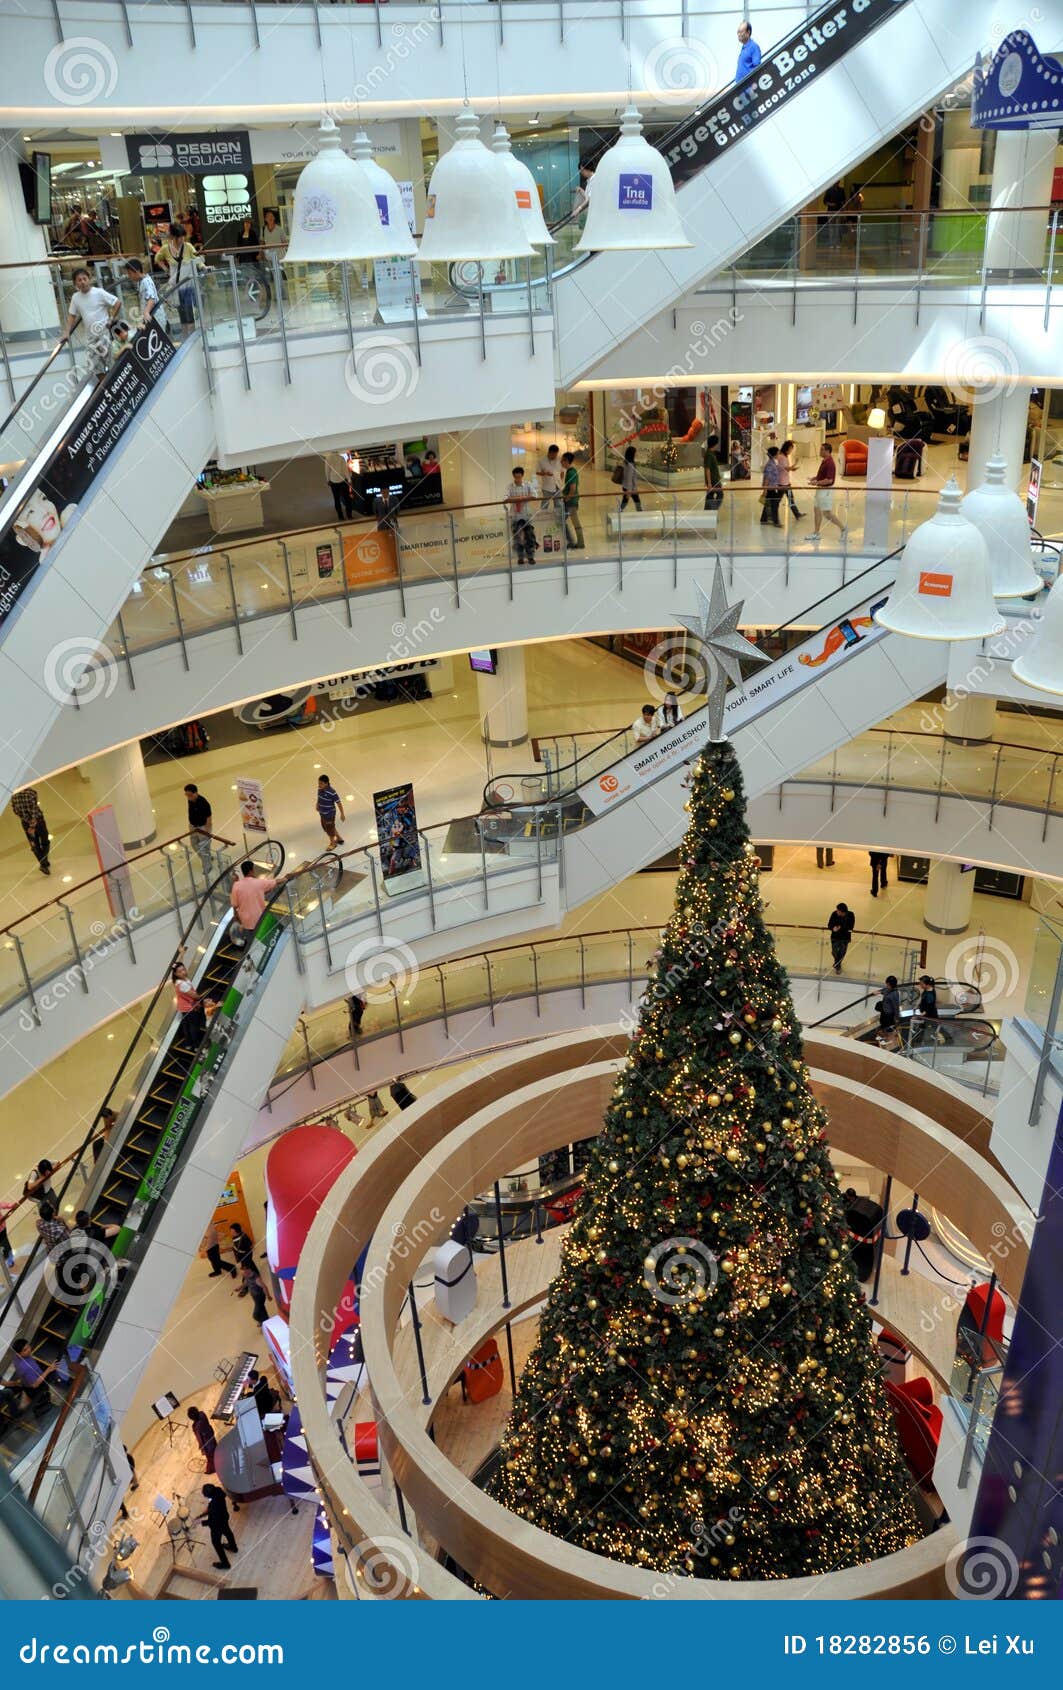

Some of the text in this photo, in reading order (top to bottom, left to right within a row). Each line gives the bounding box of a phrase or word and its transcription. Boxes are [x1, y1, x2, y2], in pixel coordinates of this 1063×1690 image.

[732, 72, 774, 111] are
[773, 9, 848, 77] Better
[714, 130, 728, 146] 6
[742, 88, 787, 125] Beacon
[784, 63, 816, 92] Zone
[176, 142, 241, 155] DESIGN
[177, 154, 243, 167] SQUARE
[206, 204, 252, 215] DESIGN
[149, 344, 171, 374] CENTRAL
[66, 362, 134, 459] Amaze your 5 senses
[92, 413, 115, 445] Central
[110, 391, 128, 415] Food
[126, 374, 140, 396] Hall
[95, 435, 113, 461] Floor
[110, 407, 133, 440] (Dazzle
[129, 383, 149, 409] Zone)
[471, 534, 484, 542] FOR
[486, 532, 504, 540] YOUR
[726, 664, 794, 713] YOUR SMART LIFE
[634, 720, 708, 772] SMART MOBILESHOP
[600, 776, 617, 790] TG
[154, 1135, 174, 1169] THE
